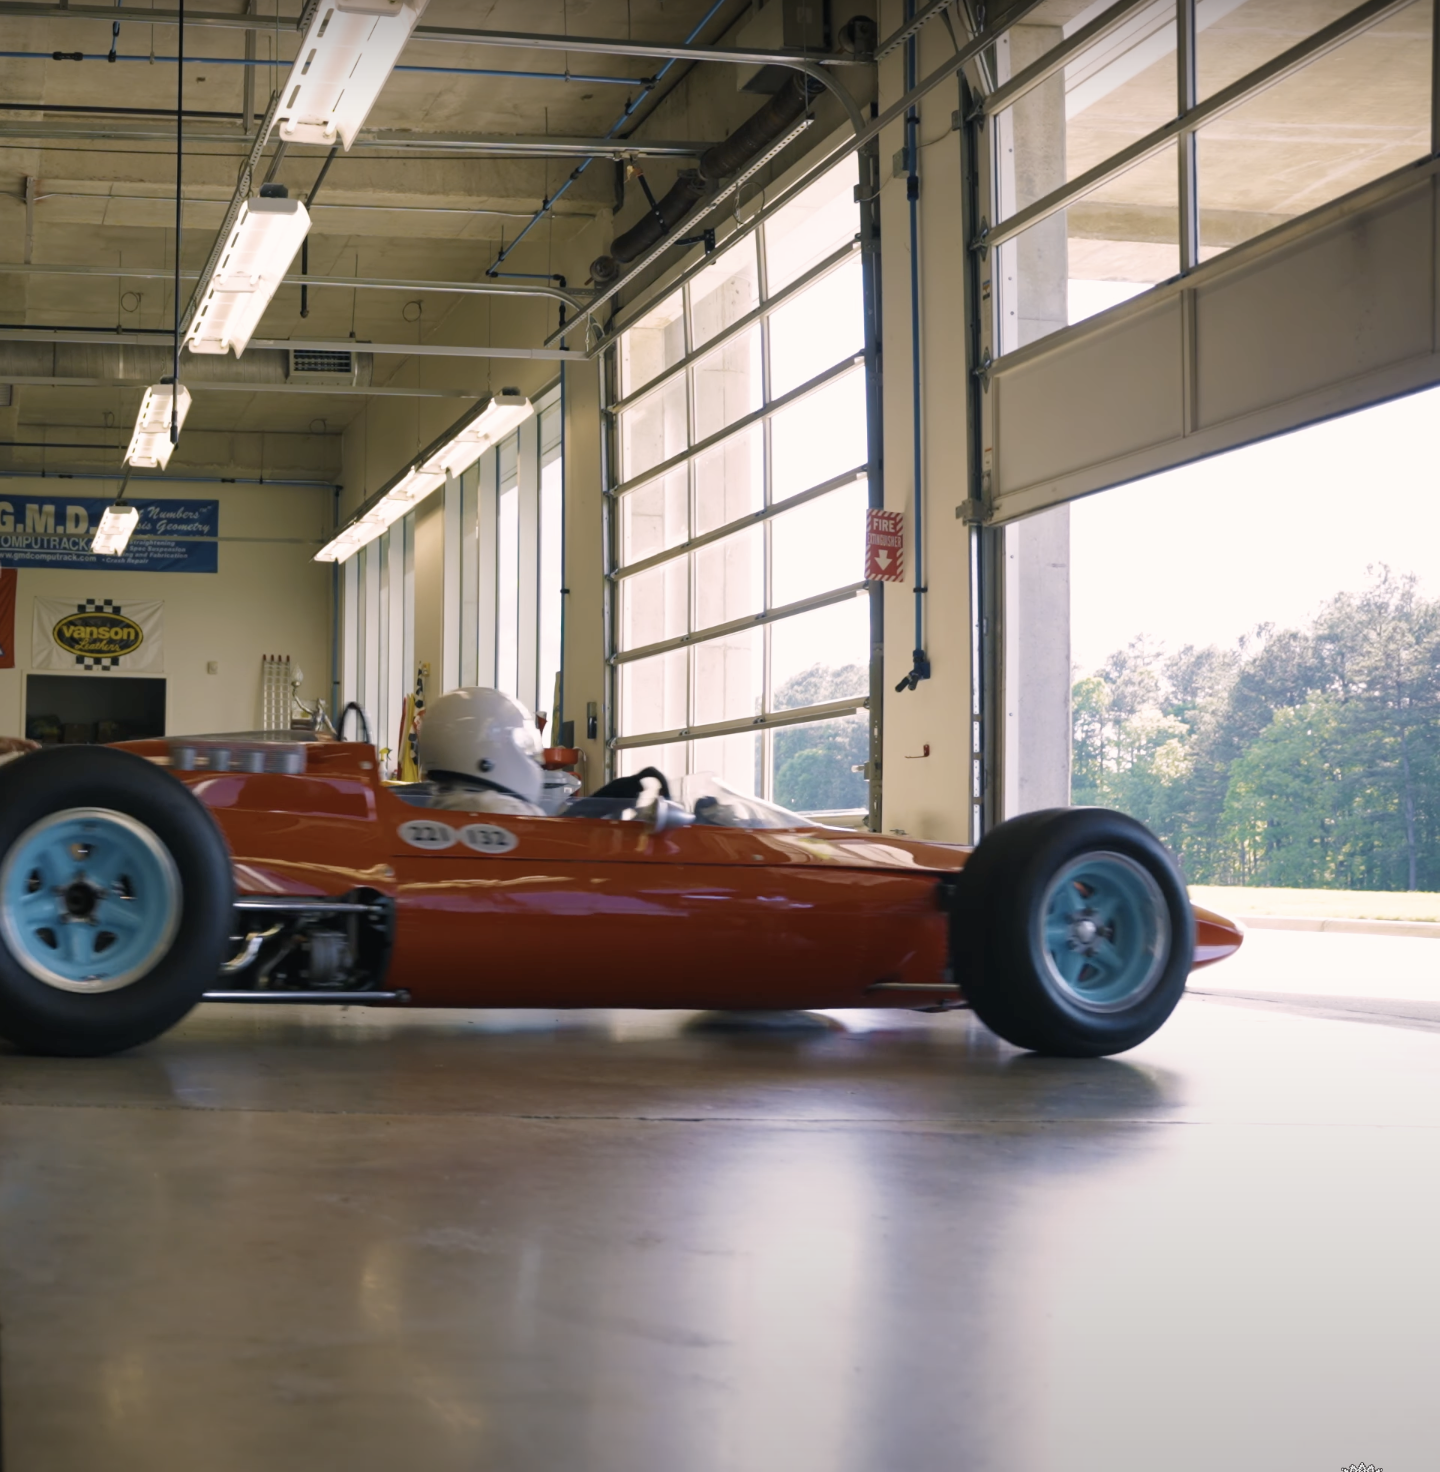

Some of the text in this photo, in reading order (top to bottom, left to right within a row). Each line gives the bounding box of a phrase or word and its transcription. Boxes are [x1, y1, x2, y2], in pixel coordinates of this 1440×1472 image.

[147, 506, 200, 519] Numbers
[156, 520, 211, 534] Geometry
[873, 517, 895, 533] FIRE
[868, 532, 902, 548] EXTINGUISHER
[62, 625, 135, 640] vanson
[75, 638, 121, 651] Leathers
[407, 825, 450, 842] 221
[466, 829, 509, 846] 132
